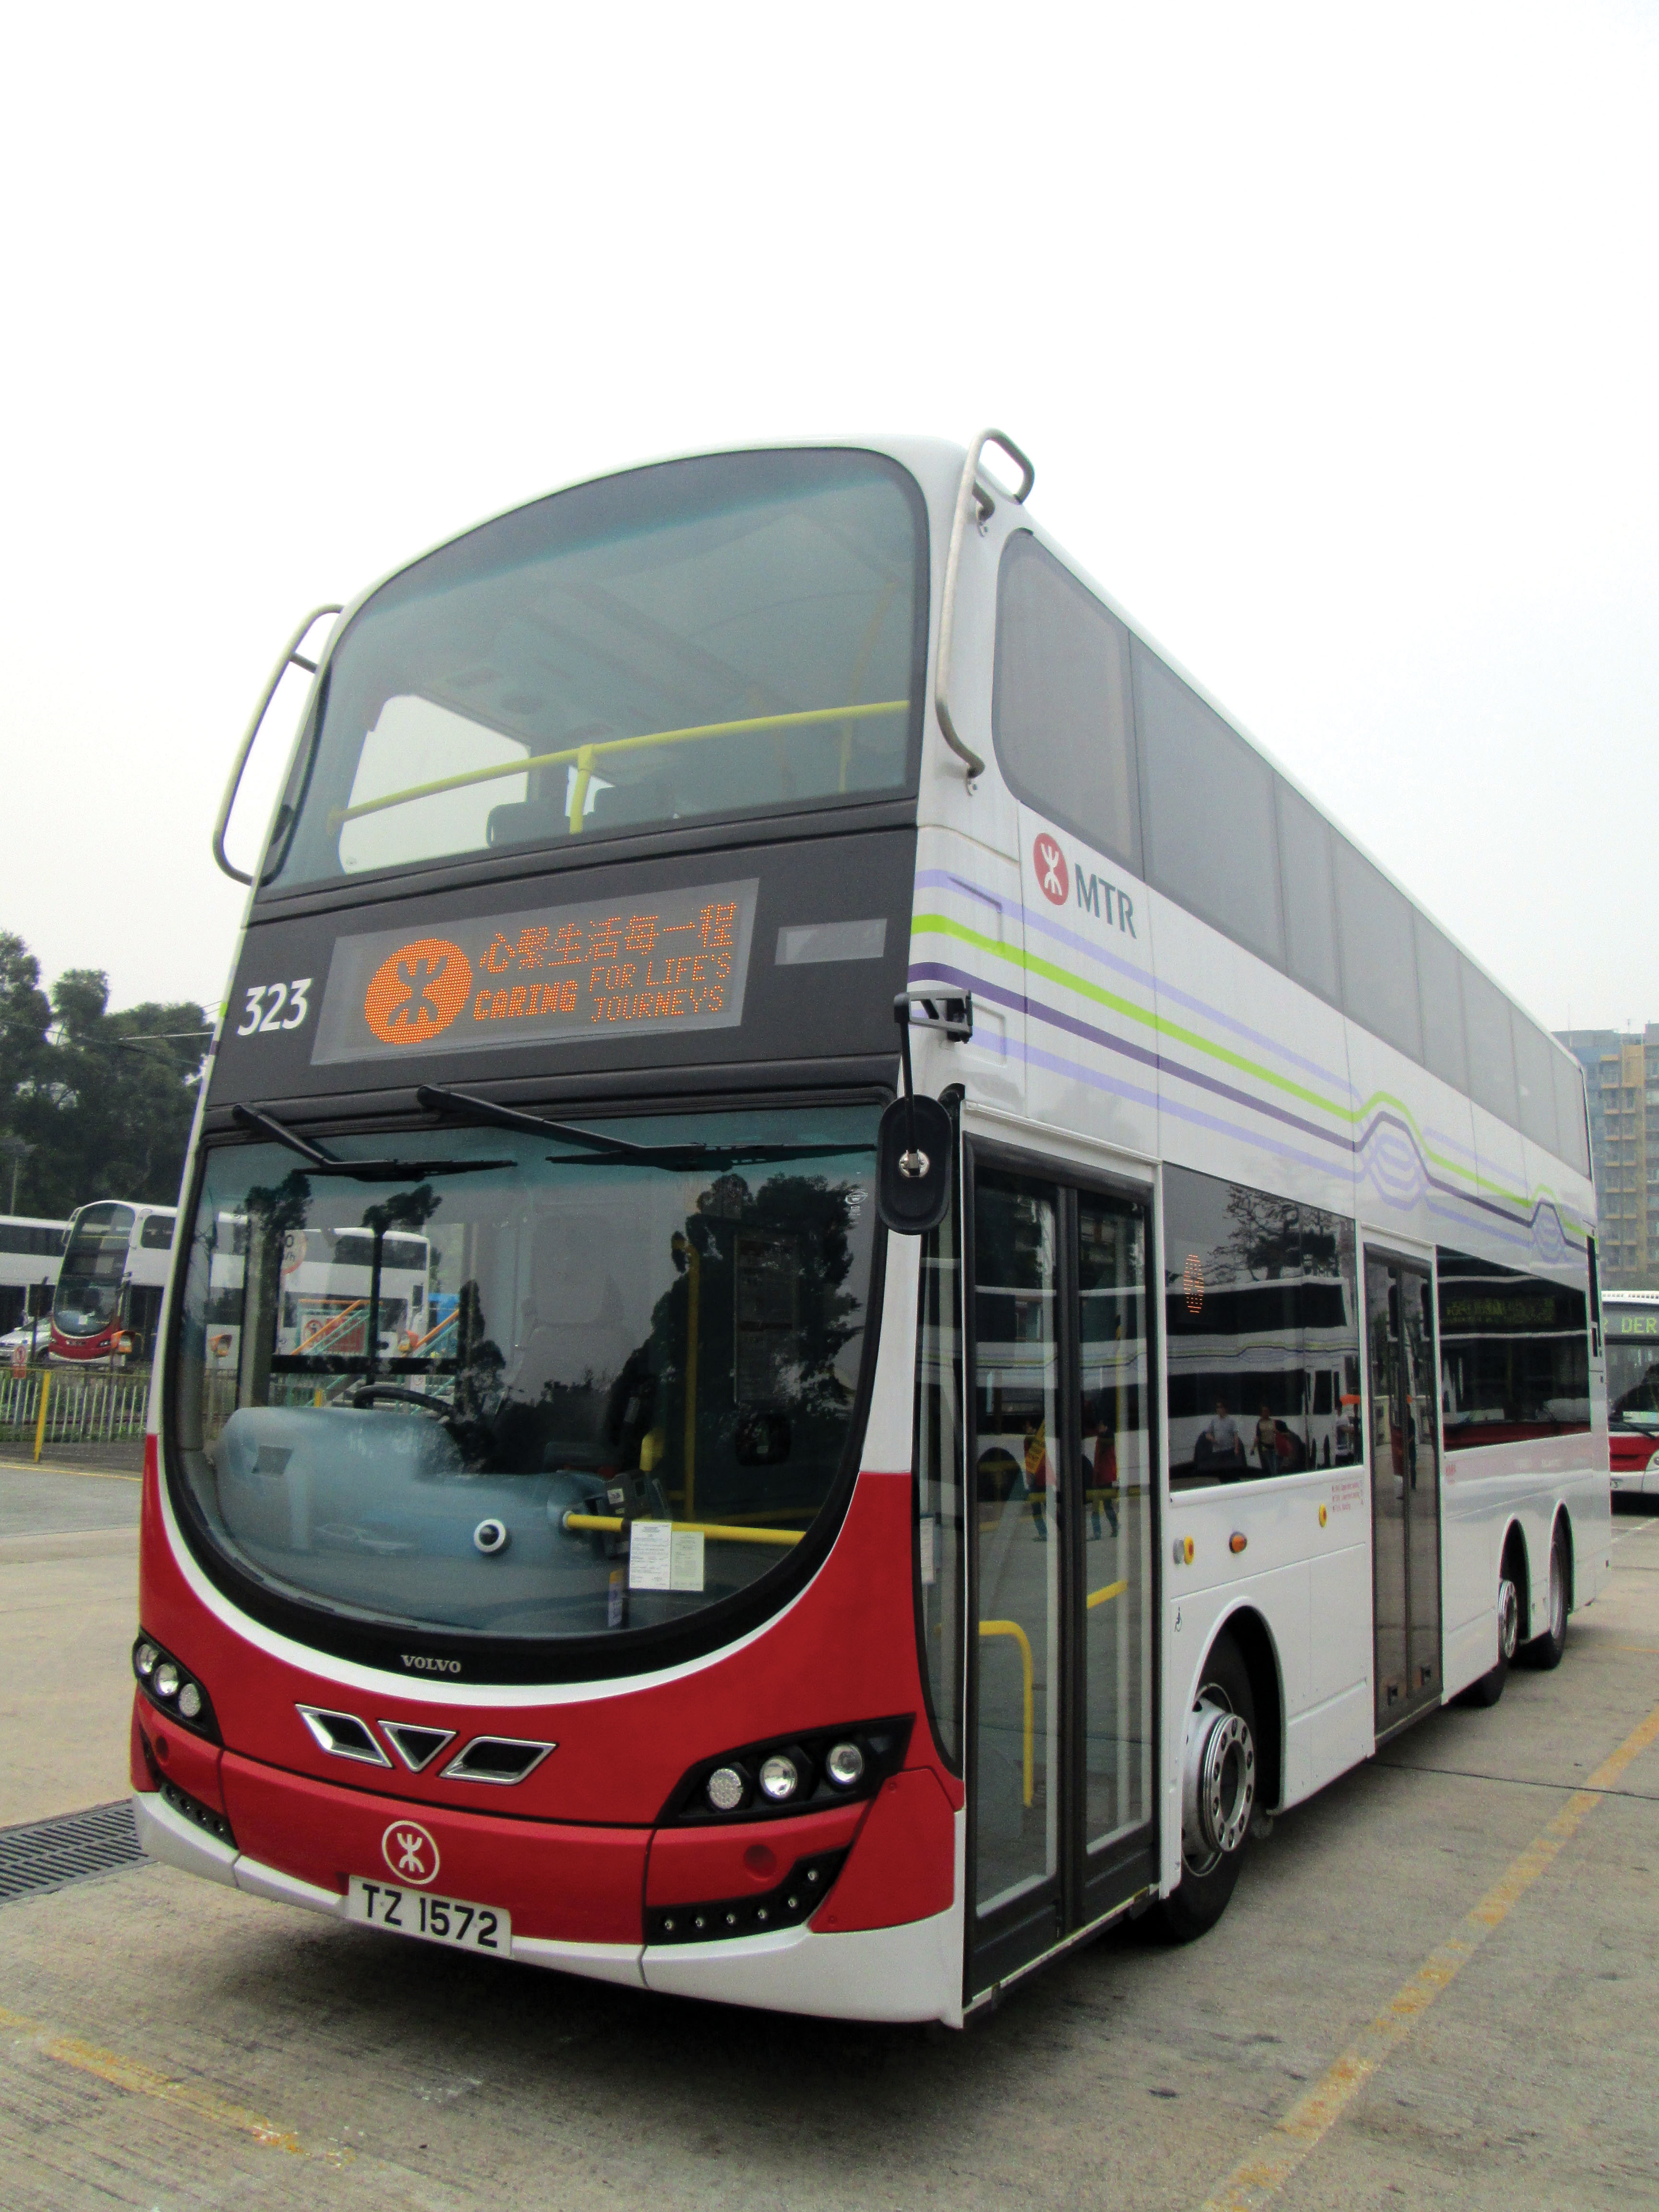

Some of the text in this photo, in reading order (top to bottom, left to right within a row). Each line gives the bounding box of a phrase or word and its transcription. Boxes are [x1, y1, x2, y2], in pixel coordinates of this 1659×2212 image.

[1075, 863, 1137, 939] MTR
[589, 952, 732, 993] FOR LIFE'S
[237, 977, 312, 1036] 323
[473, 980, 577, 1021] CARING
[591, 985, 724, 1023] JOURNEYS
[401, 1655, 461, 1673] VOLVO
[362, 1884, 498, 1948] TZ 1572
